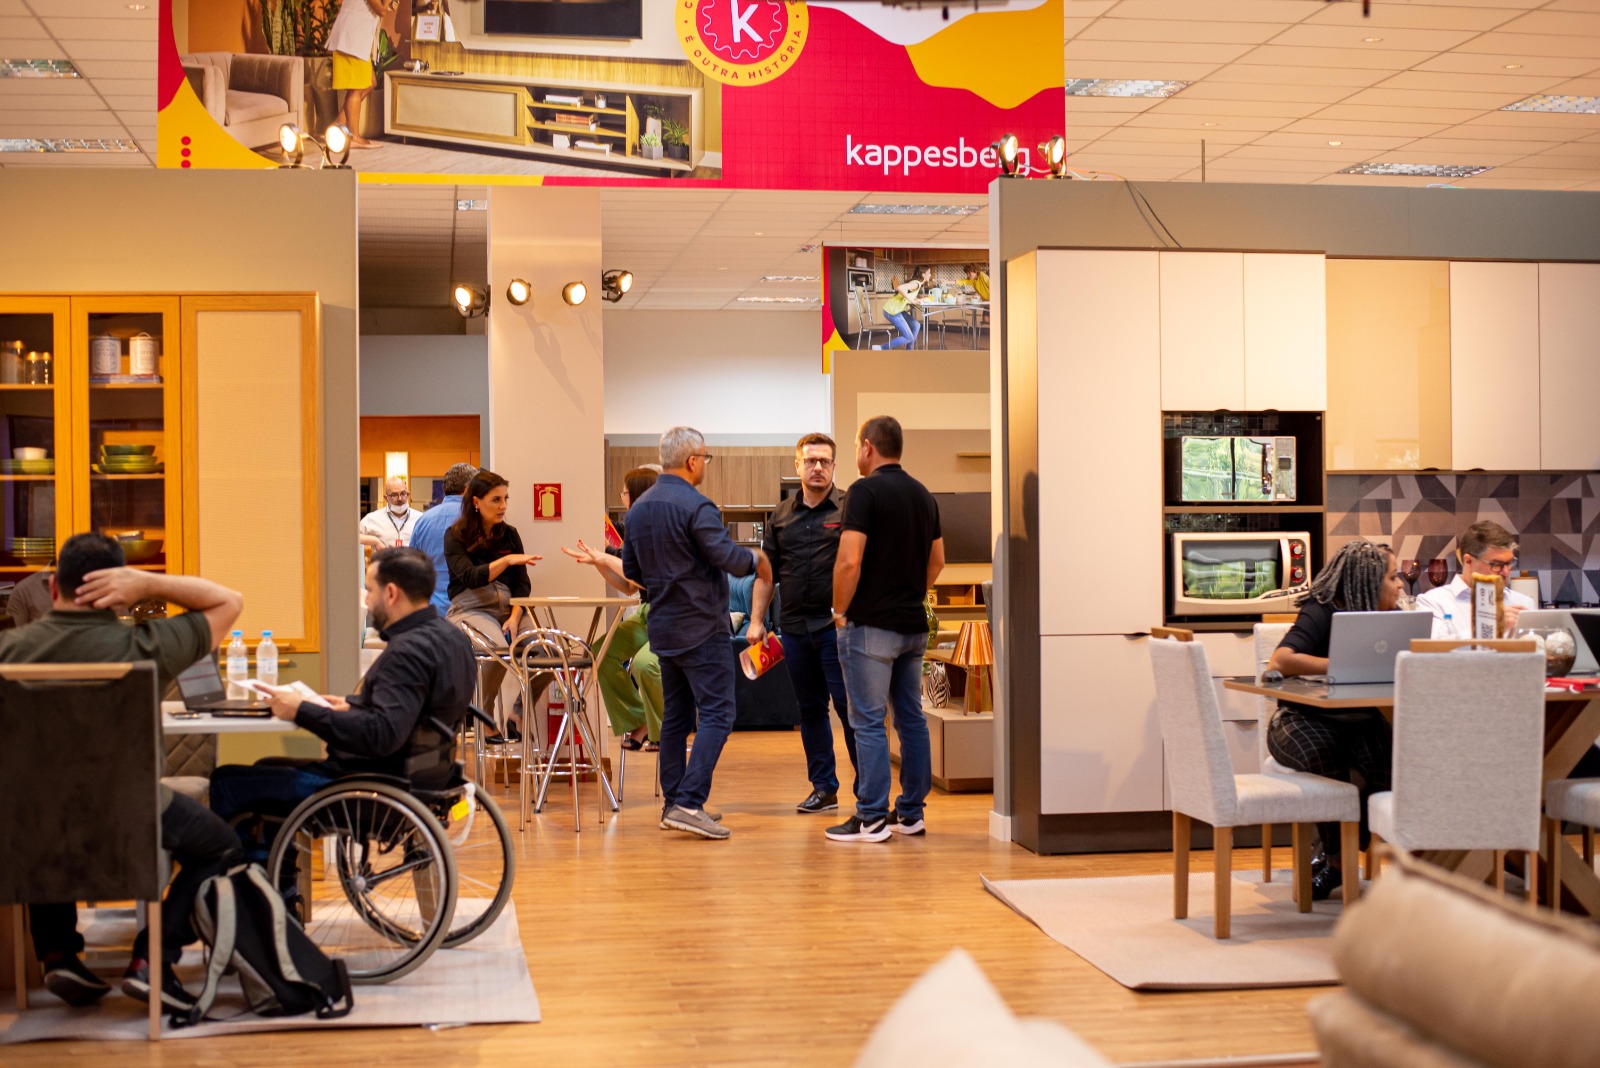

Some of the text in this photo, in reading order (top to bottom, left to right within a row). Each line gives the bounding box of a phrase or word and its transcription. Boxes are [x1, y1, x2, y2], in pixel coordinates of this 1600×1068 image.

[693, 49, 739, 79] OUTRA
[748, 30, 802, 79] HISTÓRIA
[846, 134, 1031, 177] kappesbeg
